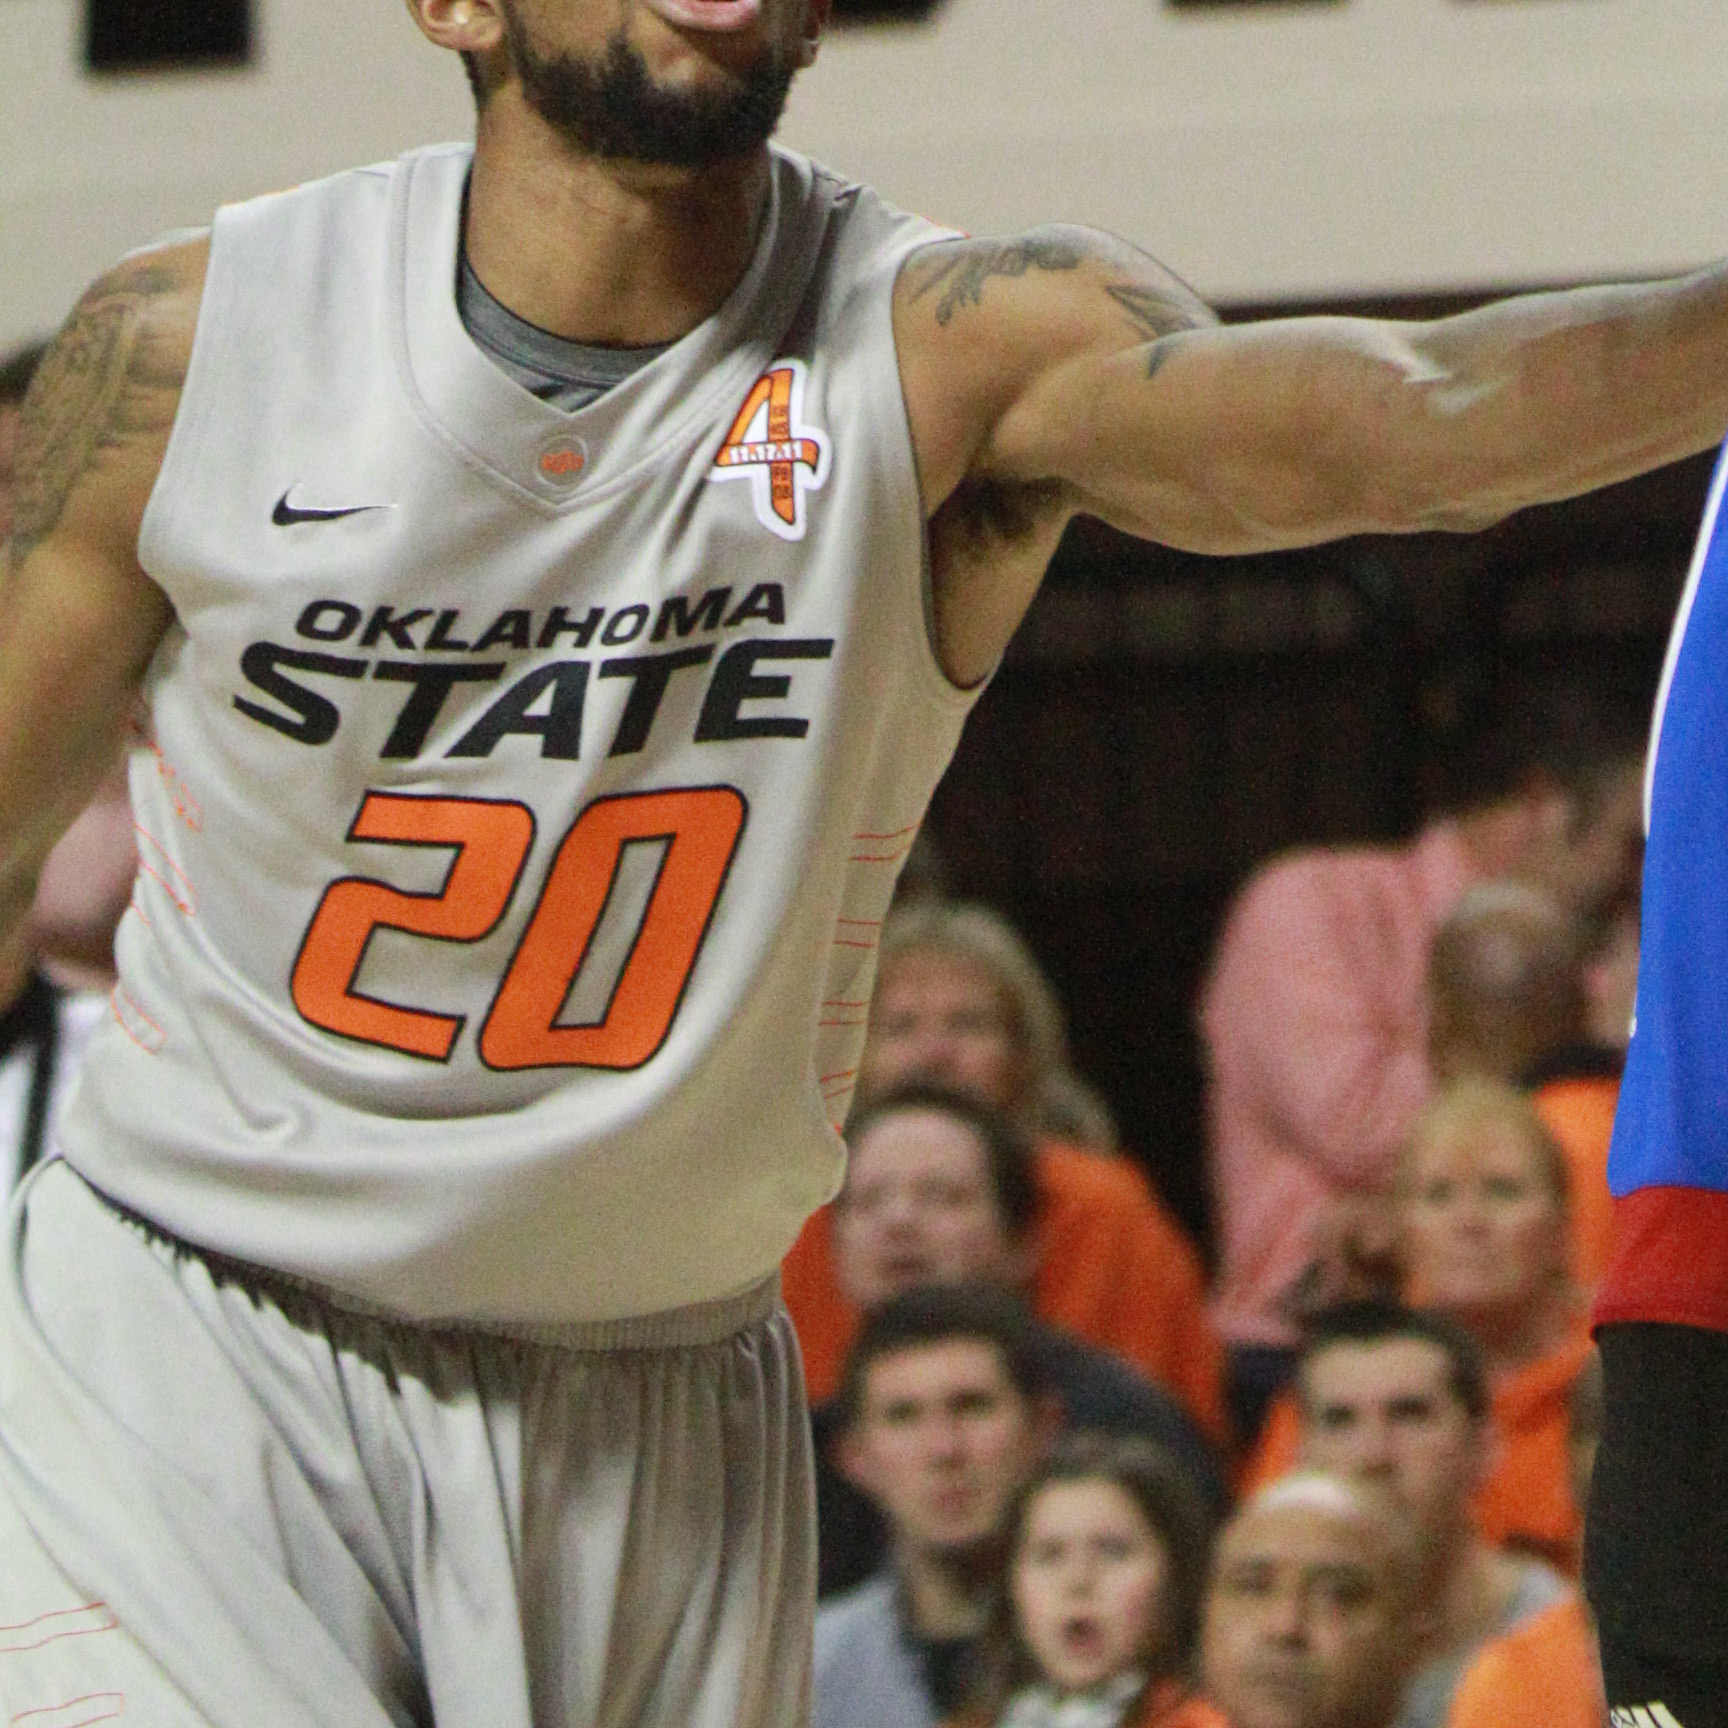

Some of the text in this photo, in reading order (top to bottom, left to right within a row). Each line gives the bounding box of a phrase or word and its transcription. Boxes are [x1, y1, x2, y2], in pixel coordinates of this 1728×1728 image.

[294, 581, 787, 653] OKLAHOMA
[232, 637, 836, 762] STATE
[289, 783, 749, 1073] 20
